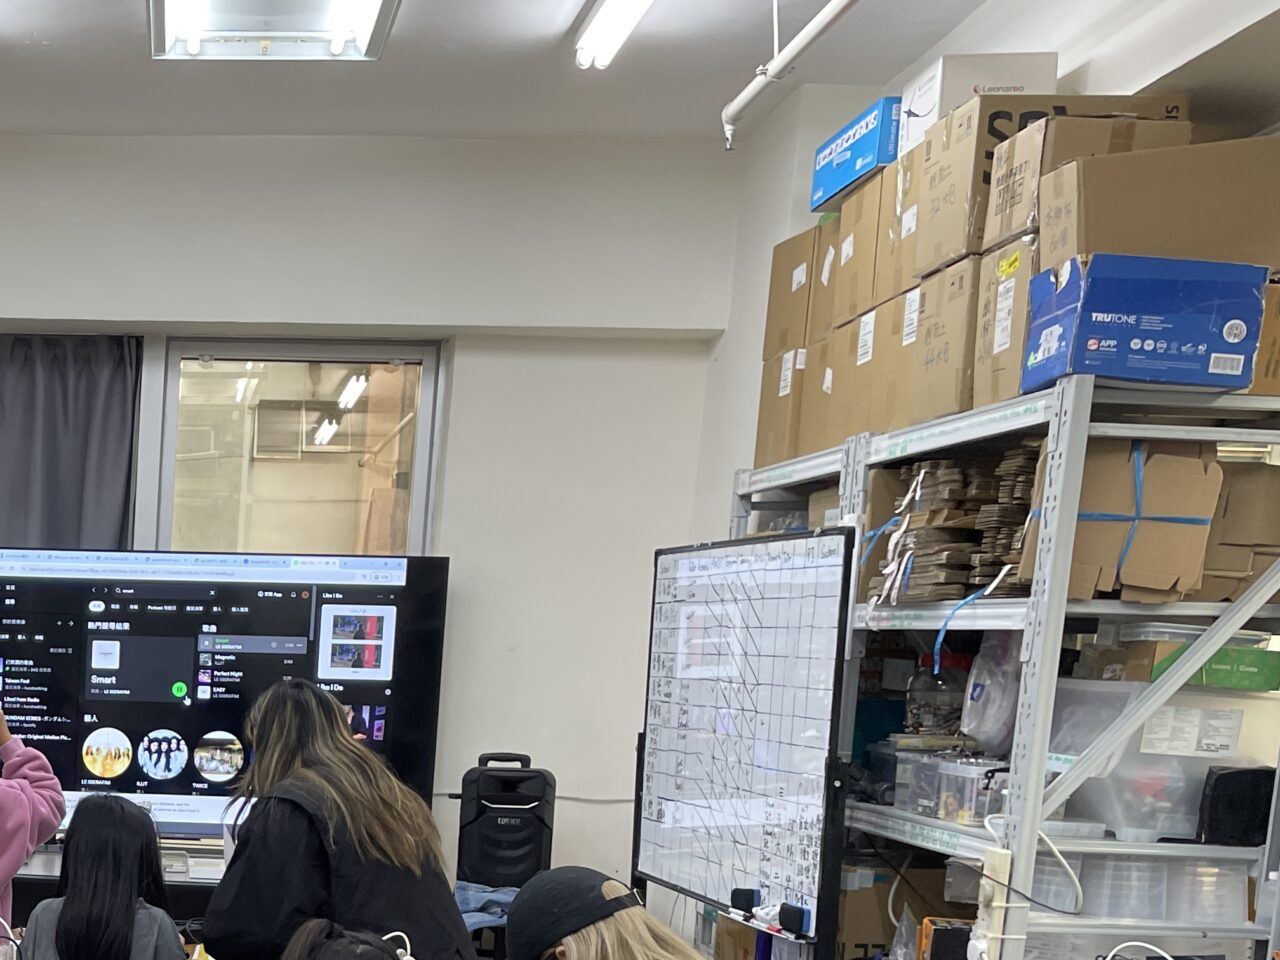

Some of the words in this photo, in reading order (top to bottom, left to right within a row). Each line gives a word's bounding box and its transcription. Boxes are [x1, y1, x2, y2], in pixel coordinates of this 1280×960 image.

[1092, 312, 1137, 324] TRUTONE
[1100, 340, 1117, 348] APP
[91, 675, 116, 684] Smart
